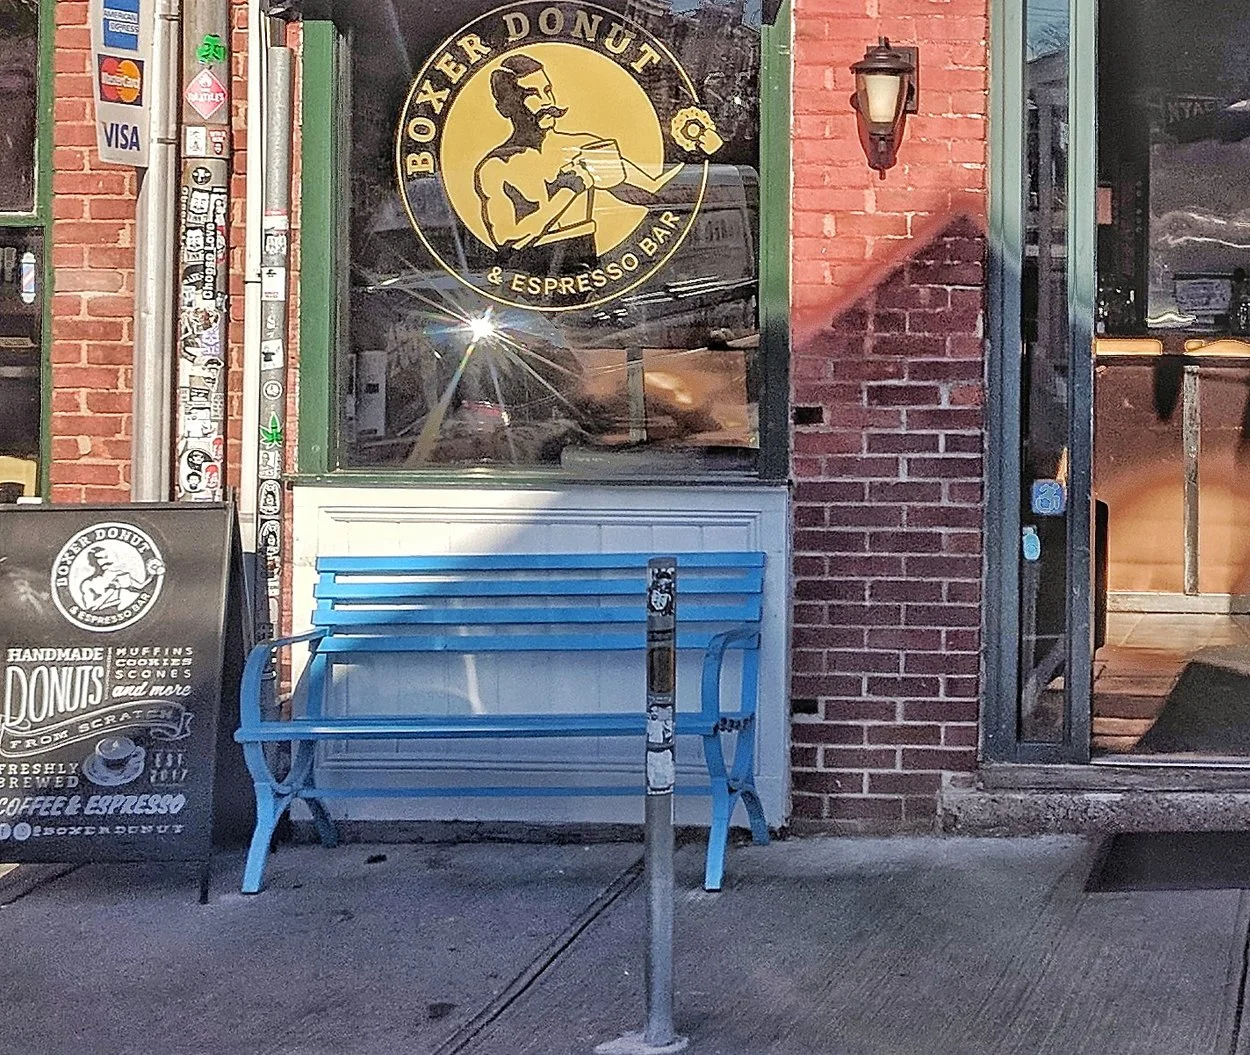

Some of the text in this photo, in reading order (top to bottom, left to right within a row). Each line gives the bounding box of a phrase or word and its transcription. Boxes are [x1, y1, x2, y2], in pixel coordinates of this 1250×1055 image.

[103, 10, 138, 23] AMERICAN
[405, 6, 661, 177] BOXER DONUT
[102, 122, 141, 151] VISA
[487, 209, 681, 296] & ESPRESSO BAR
[94, 527, 150, 553] DONUT
[77, 609, 132, 624] ESPRESSO
[131, 592, 151, 612] BAR
[7, 647, 104, 662] HANDMADE
[115, 657, 192, 667] COOKIES
[116, 646, 193, 656] MUFFINS
[115, 669, 192, 679] SCONES
[4, 665, 104, 728] DONUTS
[112, 682, 191, 697] and more
[10, 709, 173, 749] FROM SCRATCH
[0, 795, 67, 816] COFFEE
[84, 794, 186, 815] ESPRESSO
